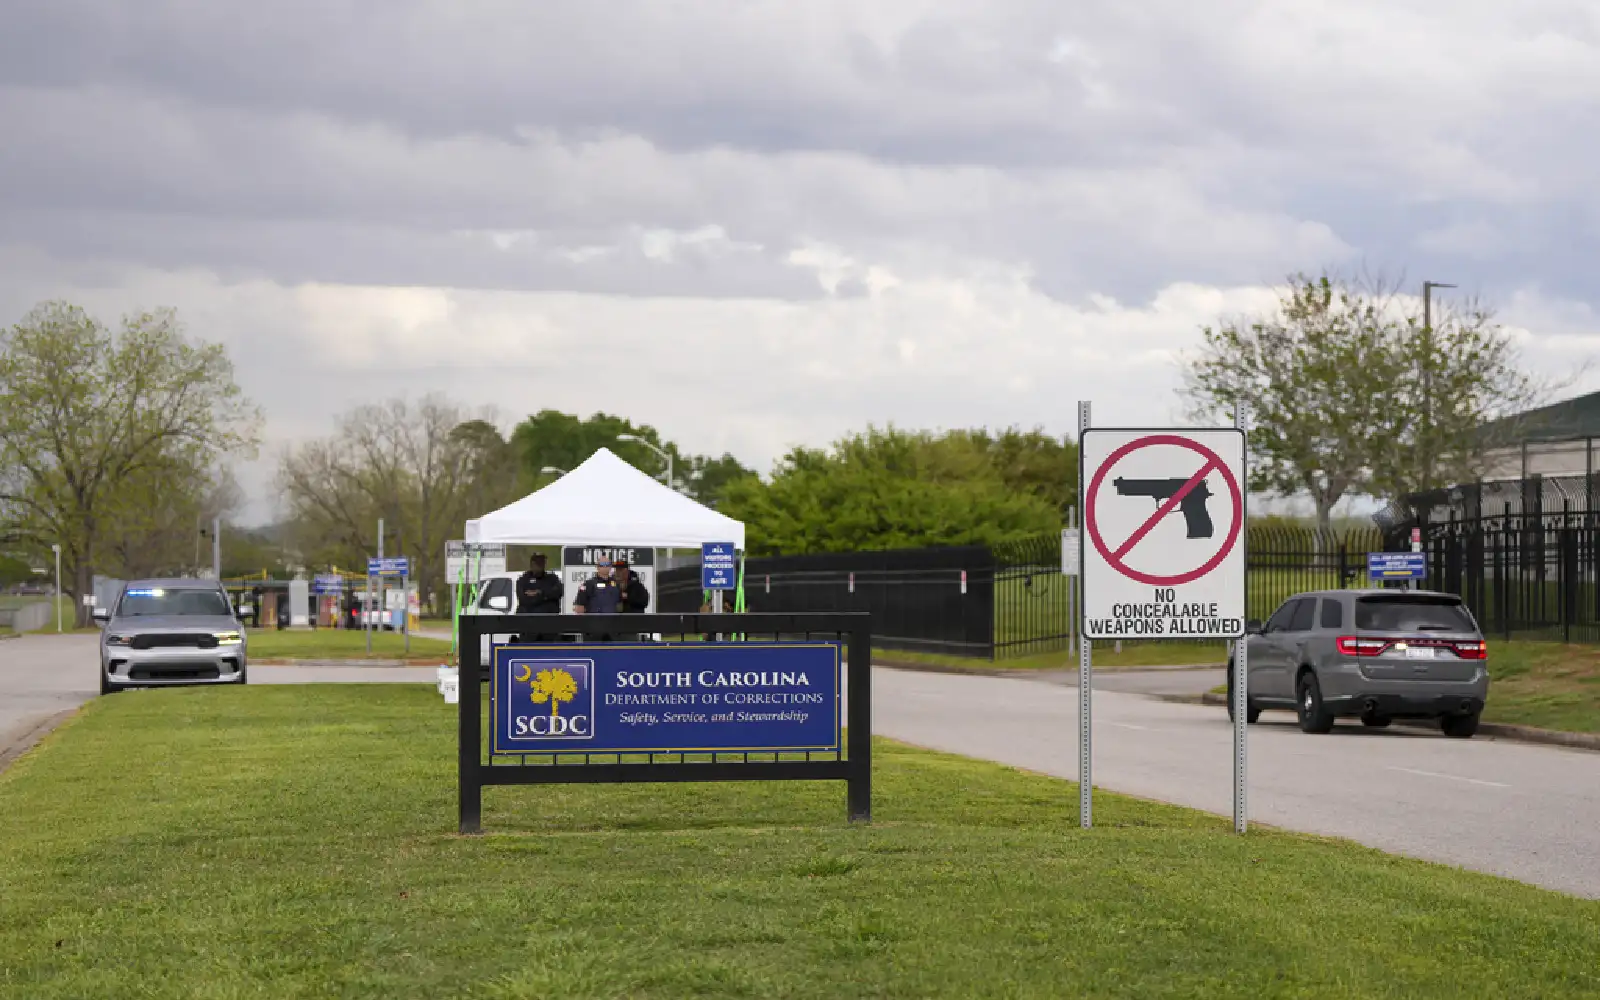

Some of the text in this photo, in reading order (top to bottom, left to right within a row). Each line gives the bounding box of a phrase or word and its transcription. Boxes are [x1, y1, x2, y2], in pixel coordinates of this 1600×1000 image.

[1155, 588, 1176, 602] NO
[1112, 603, 1218, 618] CONCEALABLE
[1089, 618, 1240, 634] WEAPONS ALLOWED
[616, 670, 810, 688] SOUTH CAROLINA
[605, 692, 823, 705] DEPARTMENT OF CORRECTIONS
[515, 715, 587, 735] SCDC
[619, 710, 809, 726] Safety, Service, and Stewardship
